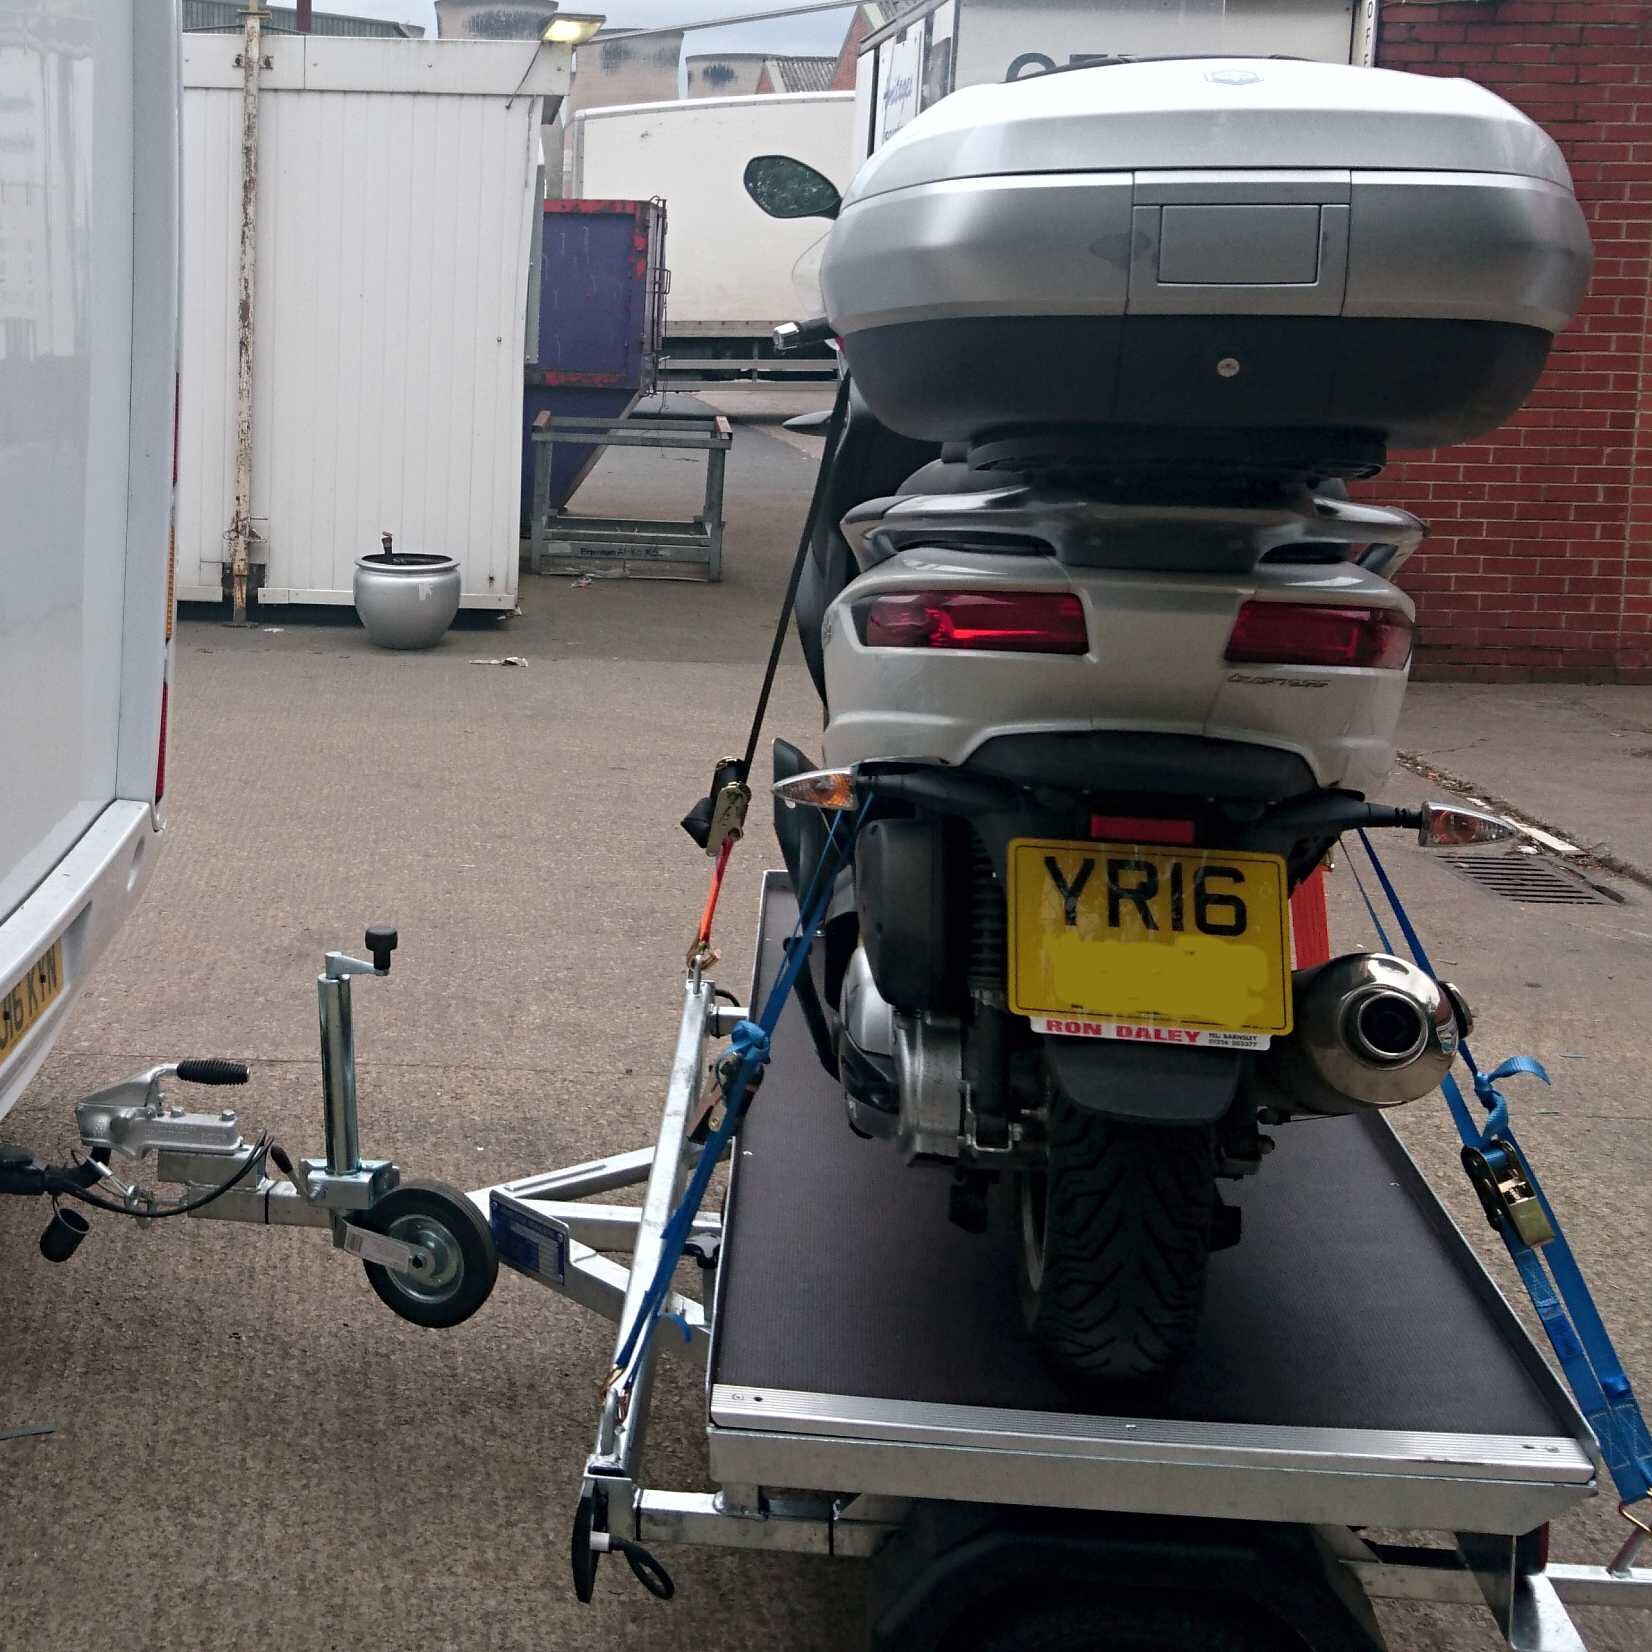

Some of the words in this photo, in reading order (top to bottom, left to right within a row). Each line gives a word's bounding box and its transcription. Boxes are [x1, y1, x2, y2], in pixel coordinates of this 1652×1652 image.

[1044, 856, 1248, 937] YR16
[1045, 1018, 1102, 1037] RON
[1115, 1023, 1201, 1044] DALEY
